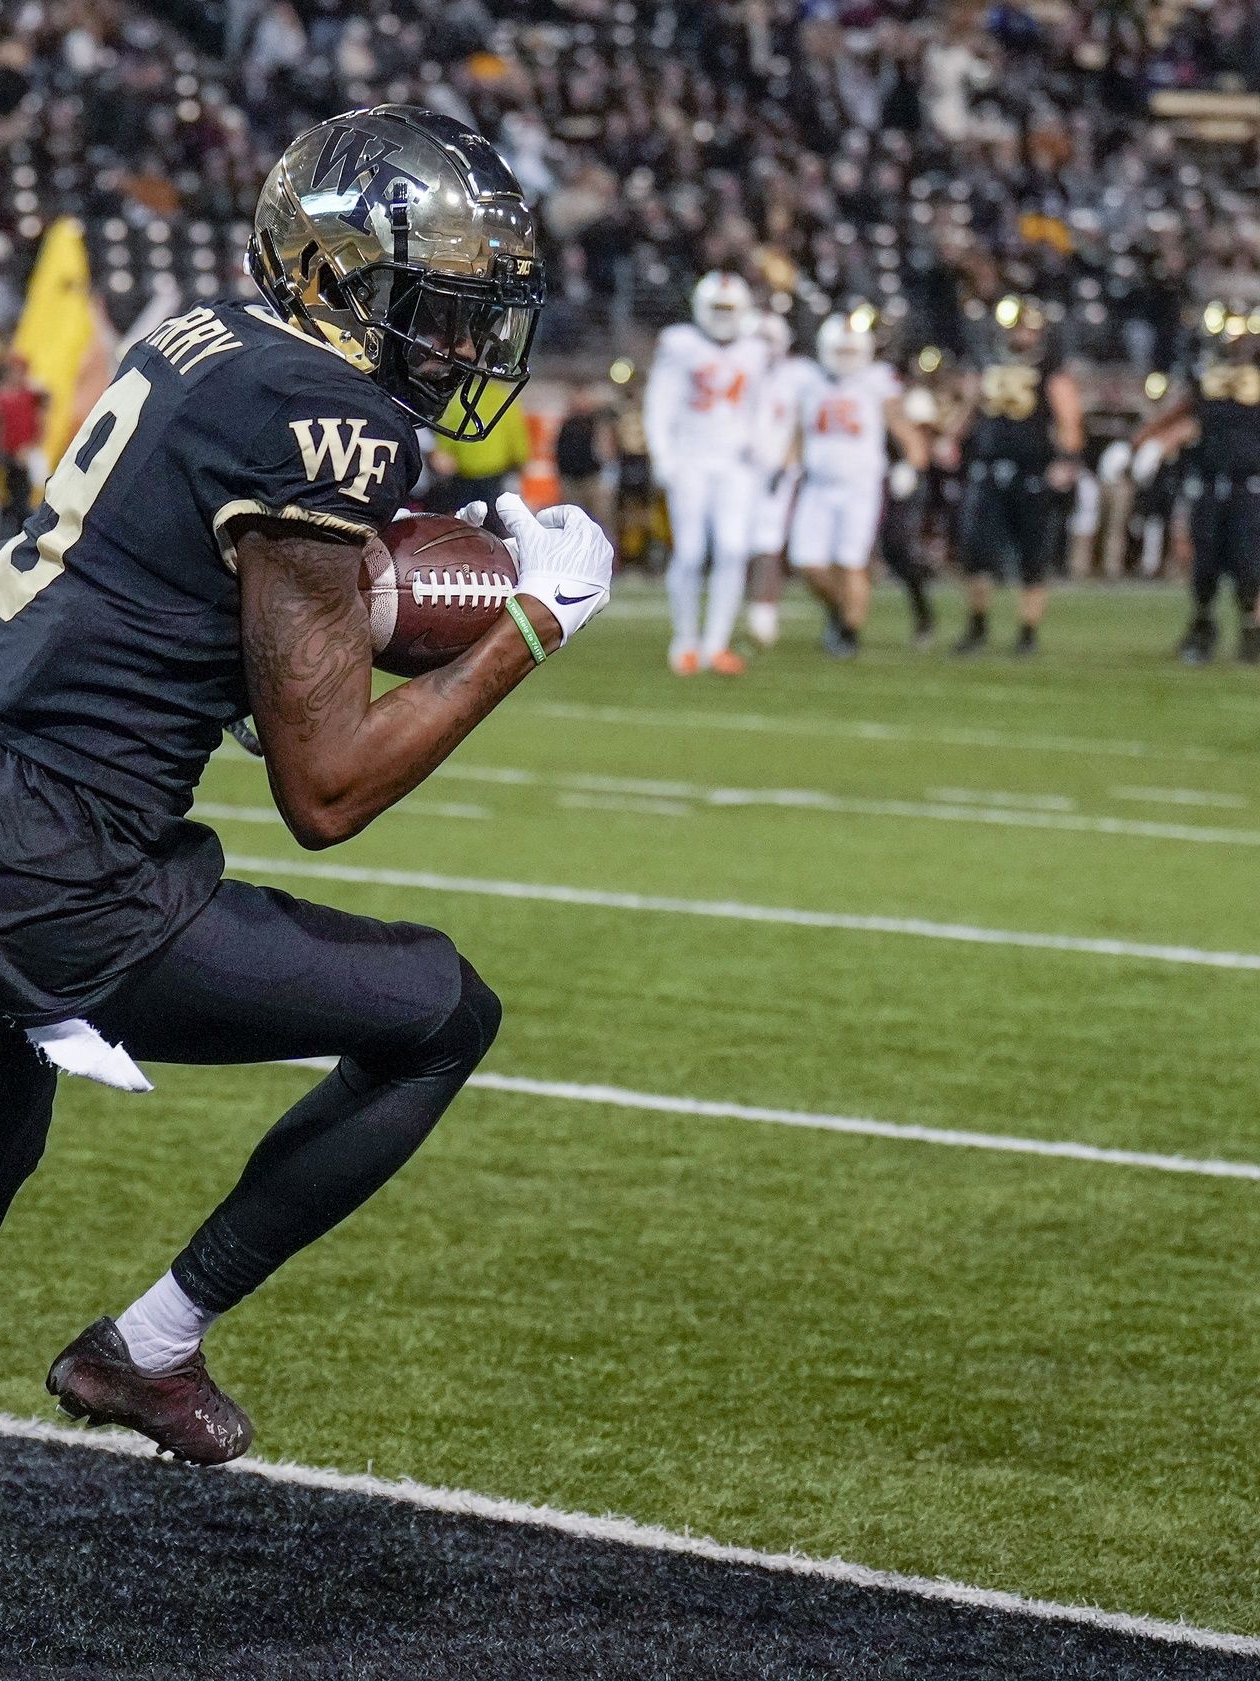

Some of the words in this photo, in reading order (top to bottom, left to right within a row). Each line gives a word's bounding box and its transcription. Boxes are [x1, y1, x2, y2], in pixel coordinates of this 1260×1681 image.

[288, 418, 400, 504] WF
[510, 602, 521, 618] Text
[519, 617, 530, 634] Help
